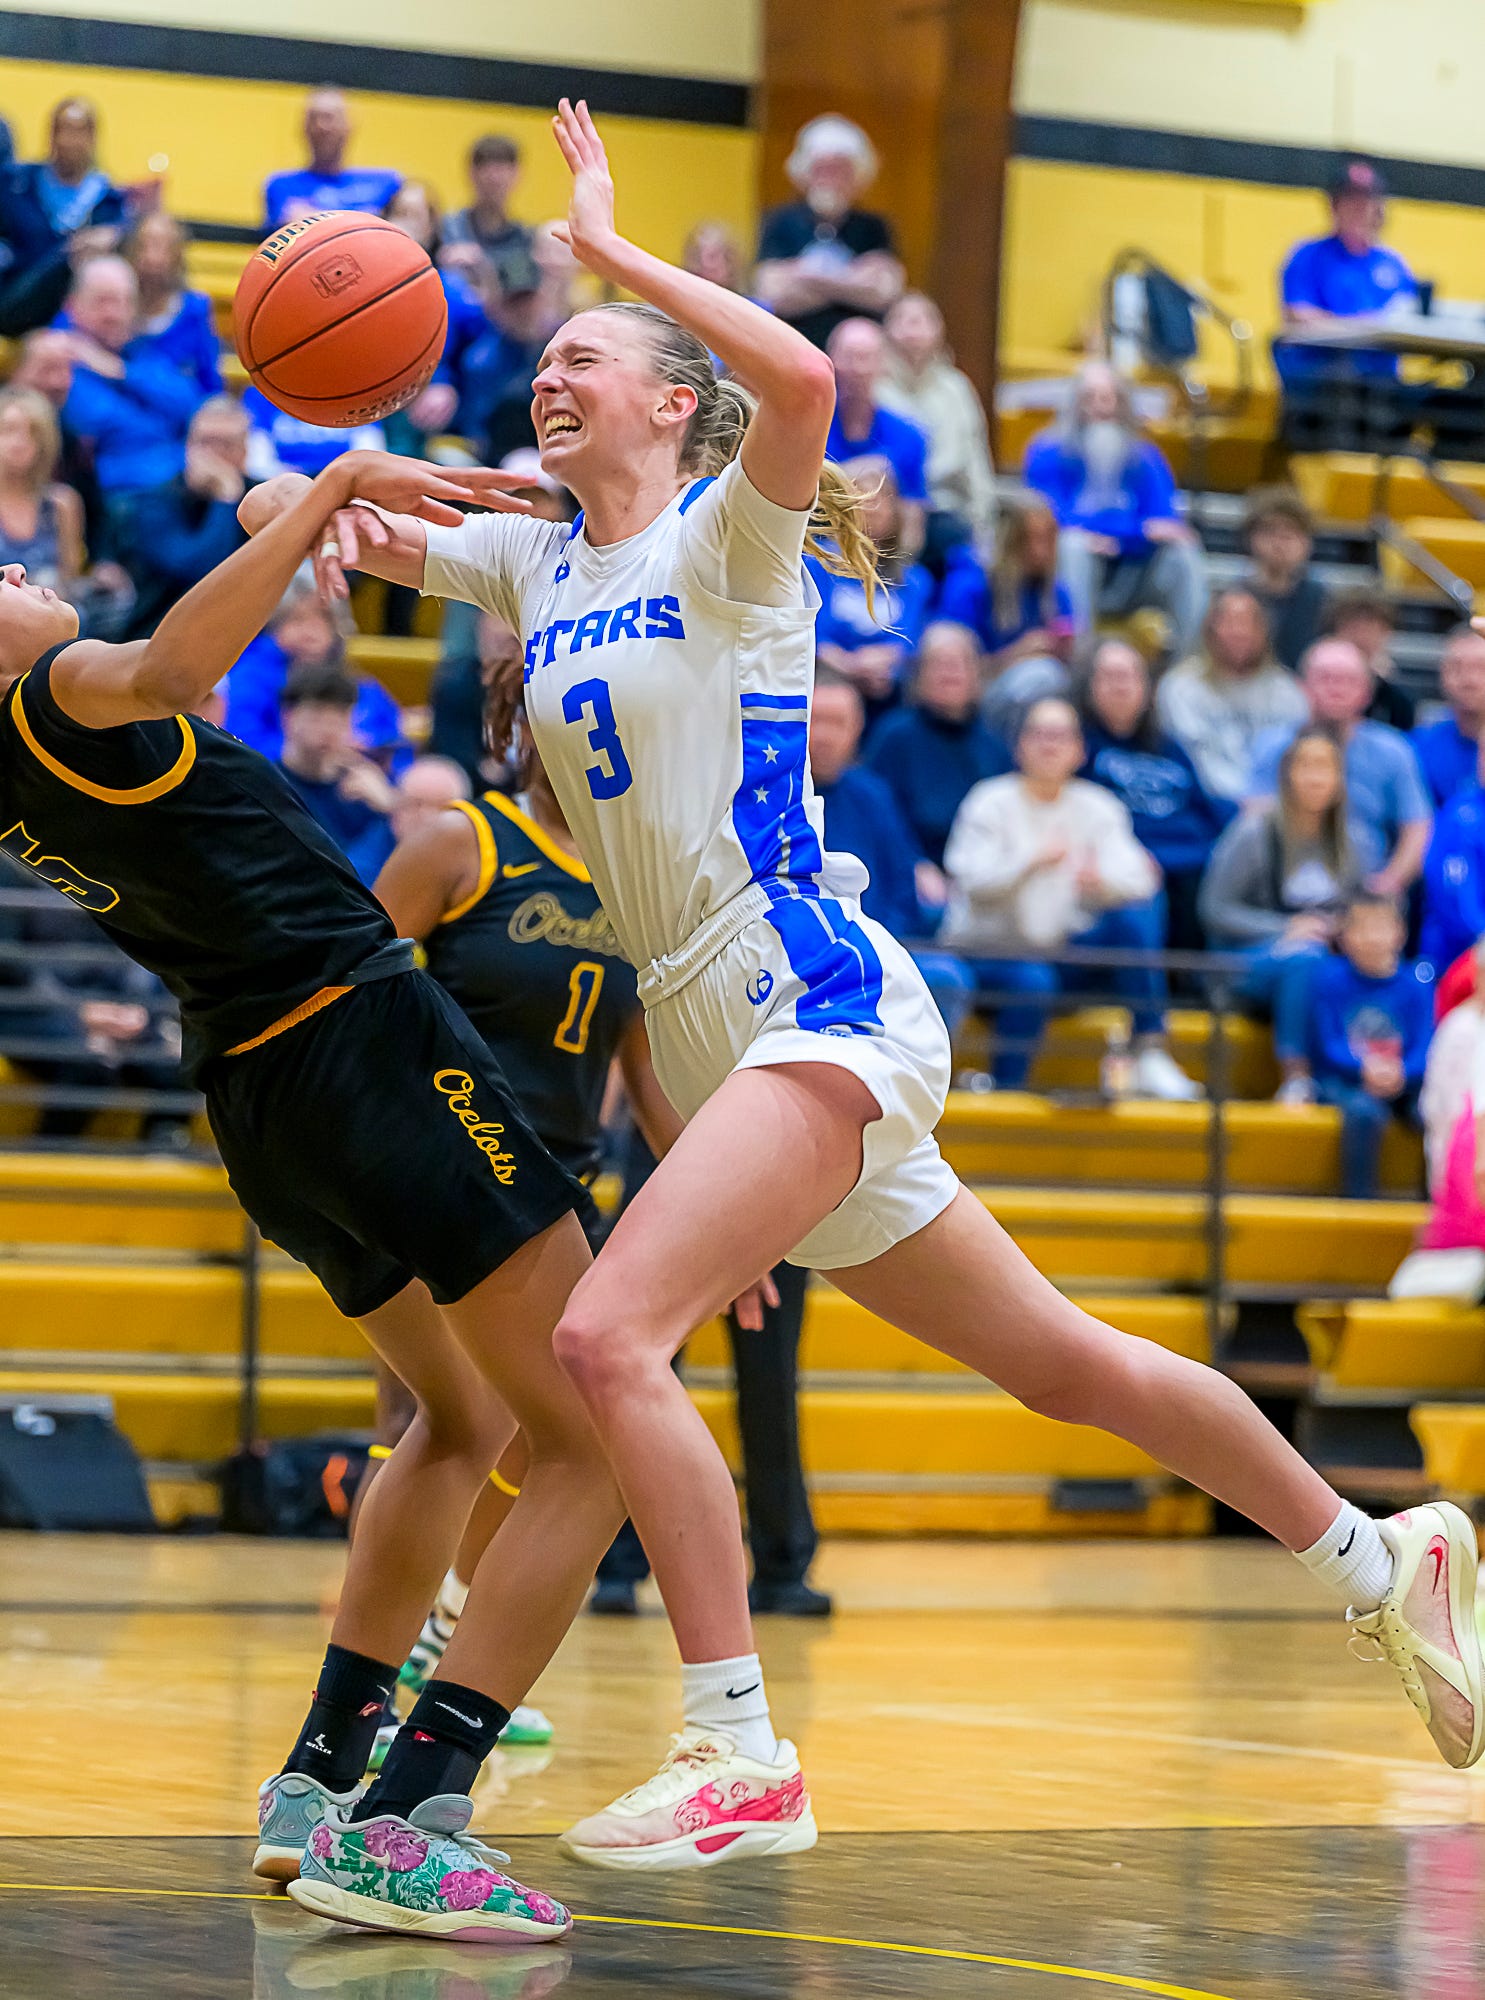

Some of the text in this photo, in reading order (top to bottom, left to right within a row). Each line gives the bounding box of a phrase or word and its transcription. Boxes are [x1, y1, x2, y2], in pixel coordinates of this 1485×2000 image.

[524, 594, 686, 685] STARS
[561, 677, 634, 800] 3
[553, 961, 605, 1054] 1
[433, 1068, 518, 1185] Ocelots
